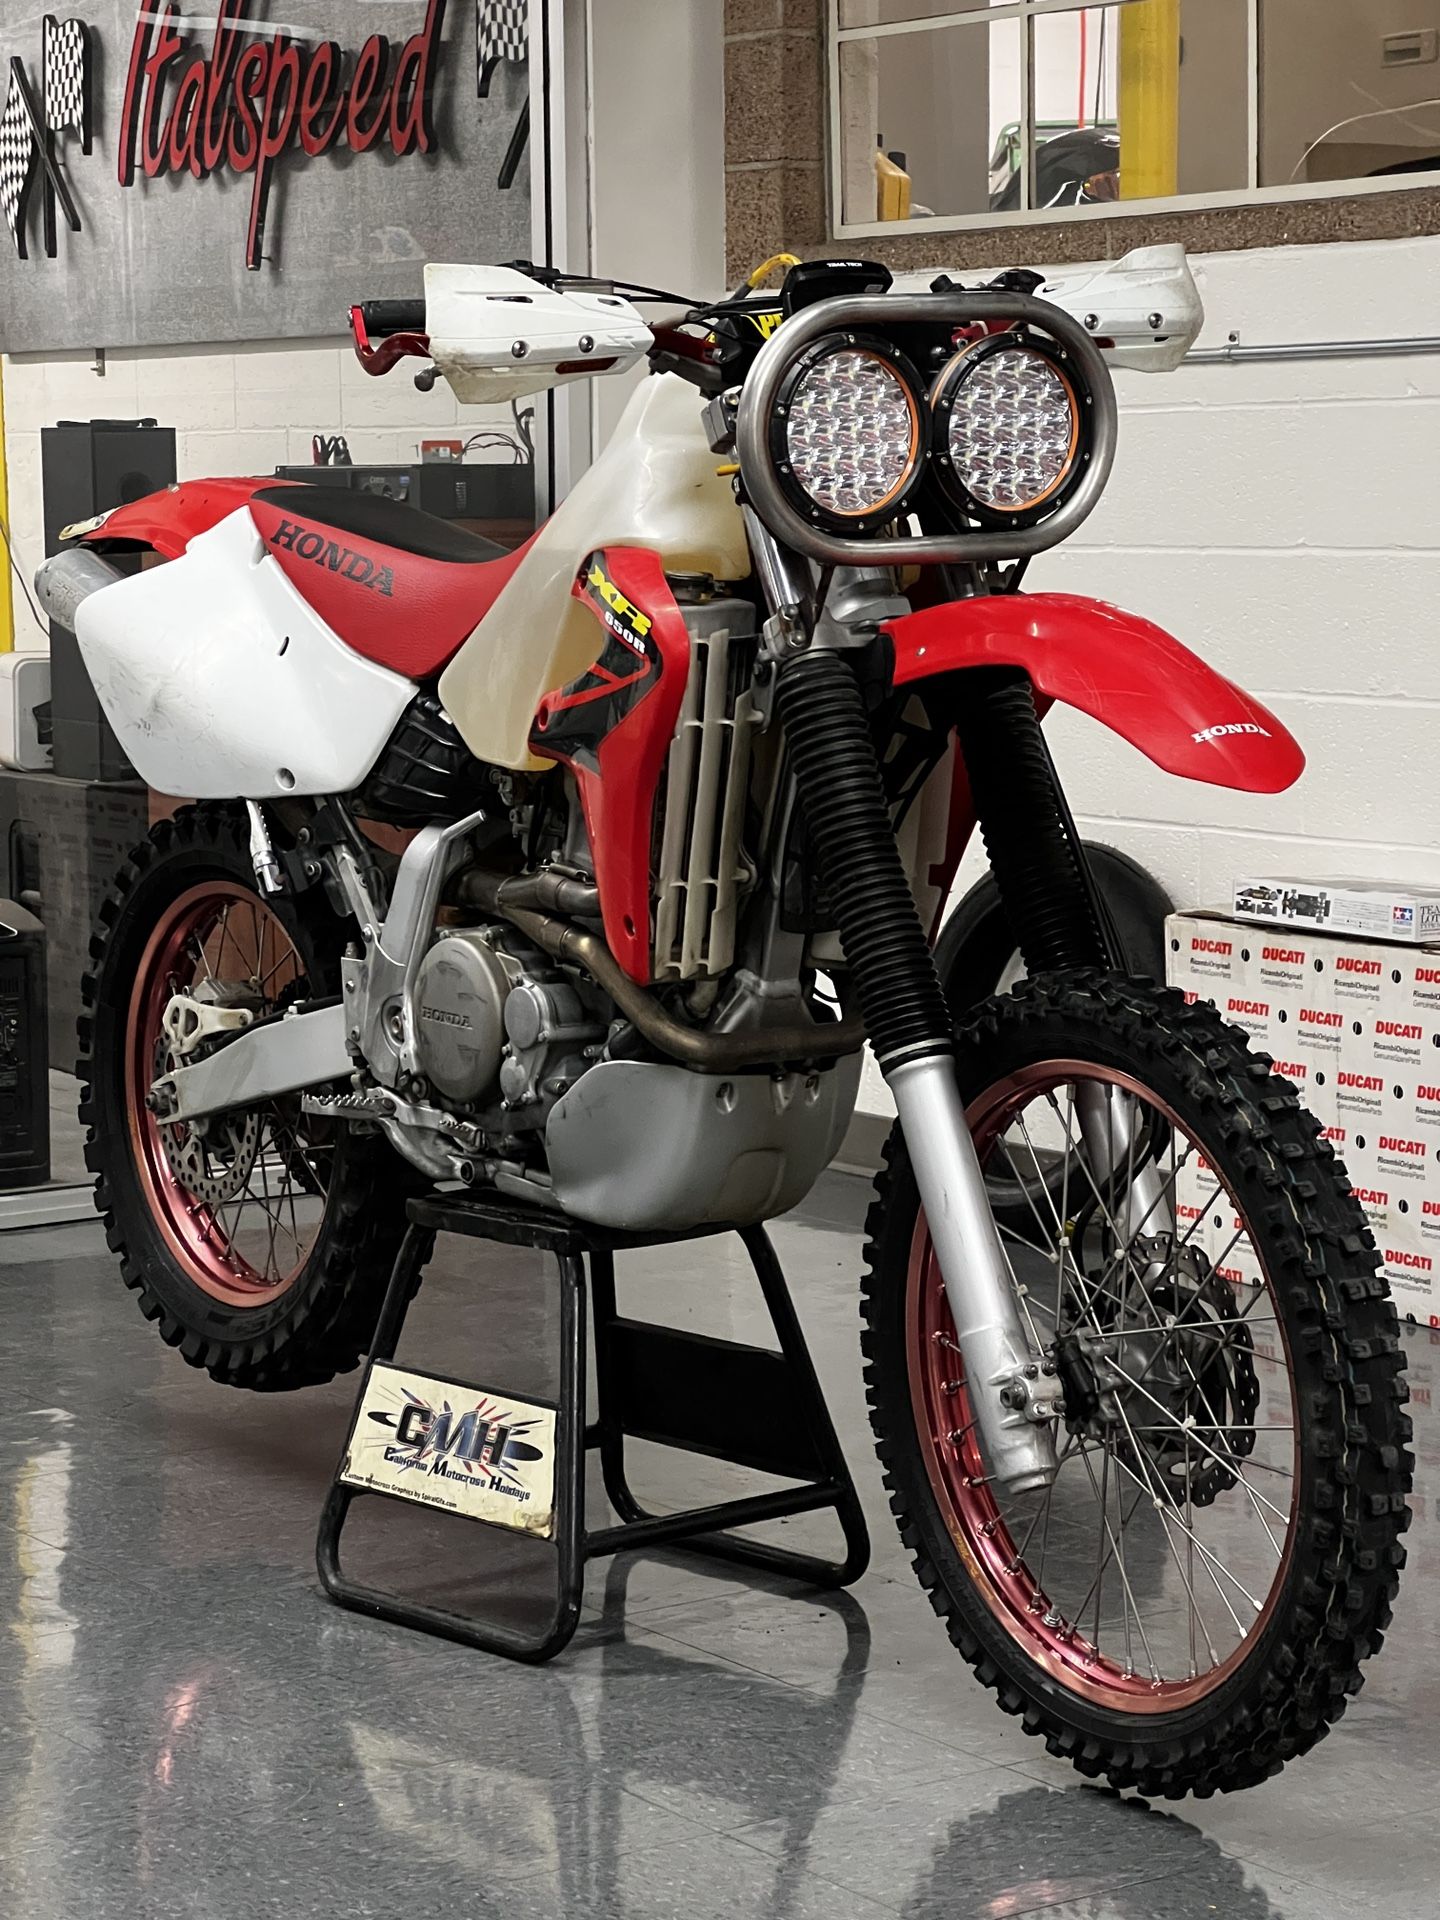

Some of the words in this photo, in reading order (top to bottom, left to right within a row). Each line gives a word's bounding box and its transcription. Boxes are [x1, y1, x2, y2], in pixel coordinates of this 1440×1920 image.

[118, 0, 448, 271] Italspeed
[270, 519, 394, 598] HONDA
[588, 564, 652, 636] XR
[604, 611, 646, 654] 650R
[1191, 938, 1233, 955] DUCATI
[1262, 947, 1305, 964] DUCATI
[1336, 957, 1382, 975] DUCATI
[1227, 998, 1269, 1017] DUCATI
[422, 1005, 474, 1030] HONDA
[1299, 1008, 1343, 1027] DUCATI
[1375, 1021, 1422, 1039] DUCATI
[1271, 1060, 1307, 1078] UCATI
[1337, 1072, 1383, 1091] DUCATI
[1379, 1136, 1426, 1156] DUCATI
[1385, 1249, 1432, 1271] DUCATI
[395, 1402, 513, 1468] CMH
[384, 1445, 428, 1472] California
[427, 1460, 486, 1488] Motocross
[489, 1475, 531, 1502] Holidays
[391, 1484, 414, 1497] Graphics
[413, 1490, 422, 1499] by
